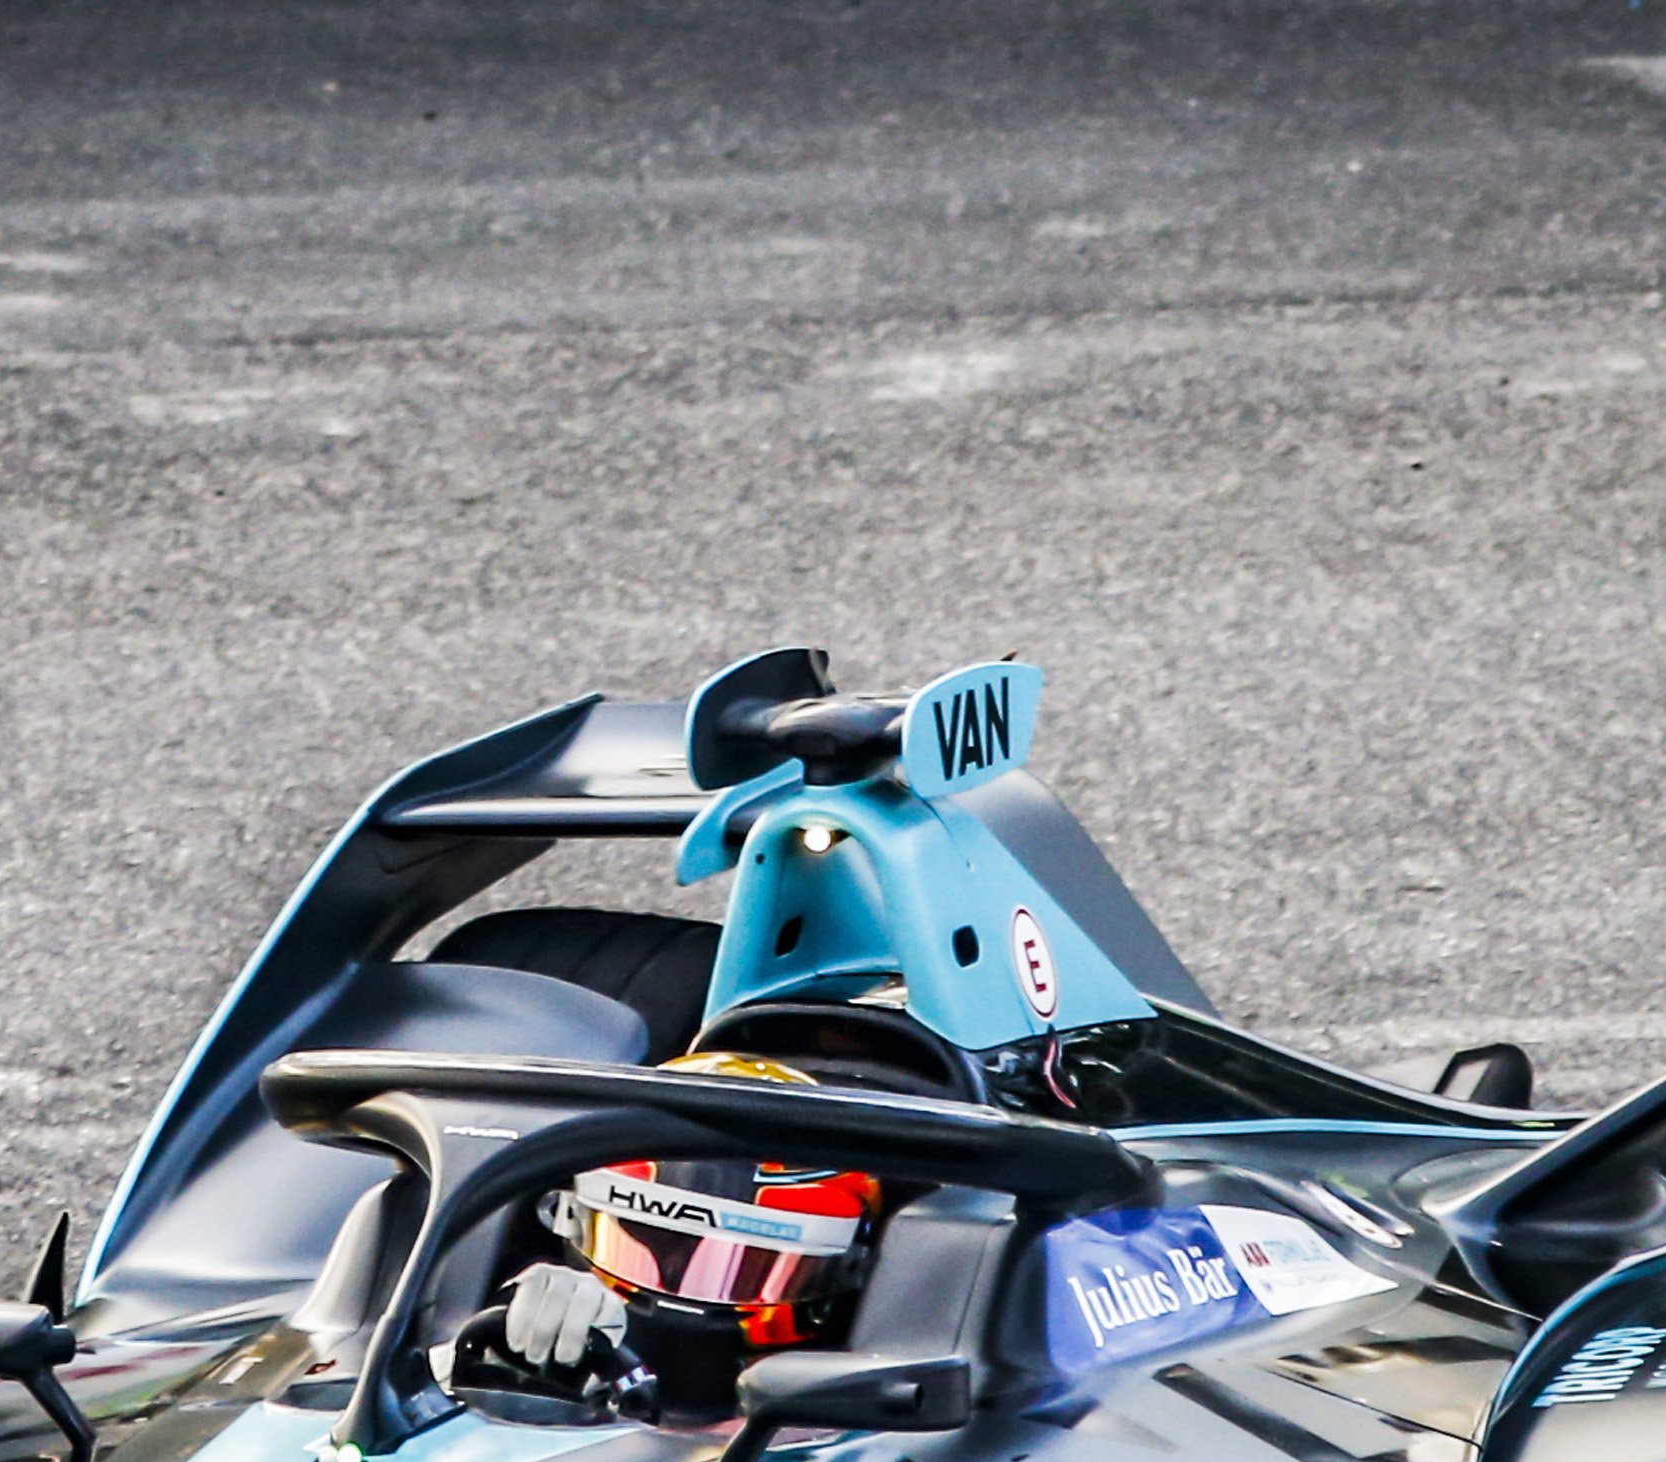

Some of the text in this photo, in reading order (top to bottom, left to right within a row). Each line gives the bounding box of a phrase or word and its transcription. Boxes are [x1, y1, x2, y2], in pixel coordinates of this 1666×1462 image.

[932, 676, 1010, 781] VAN
[609, 1184, 718, 1229] HWA
[1066, 1245, 1239, 1349] Julius Bär
